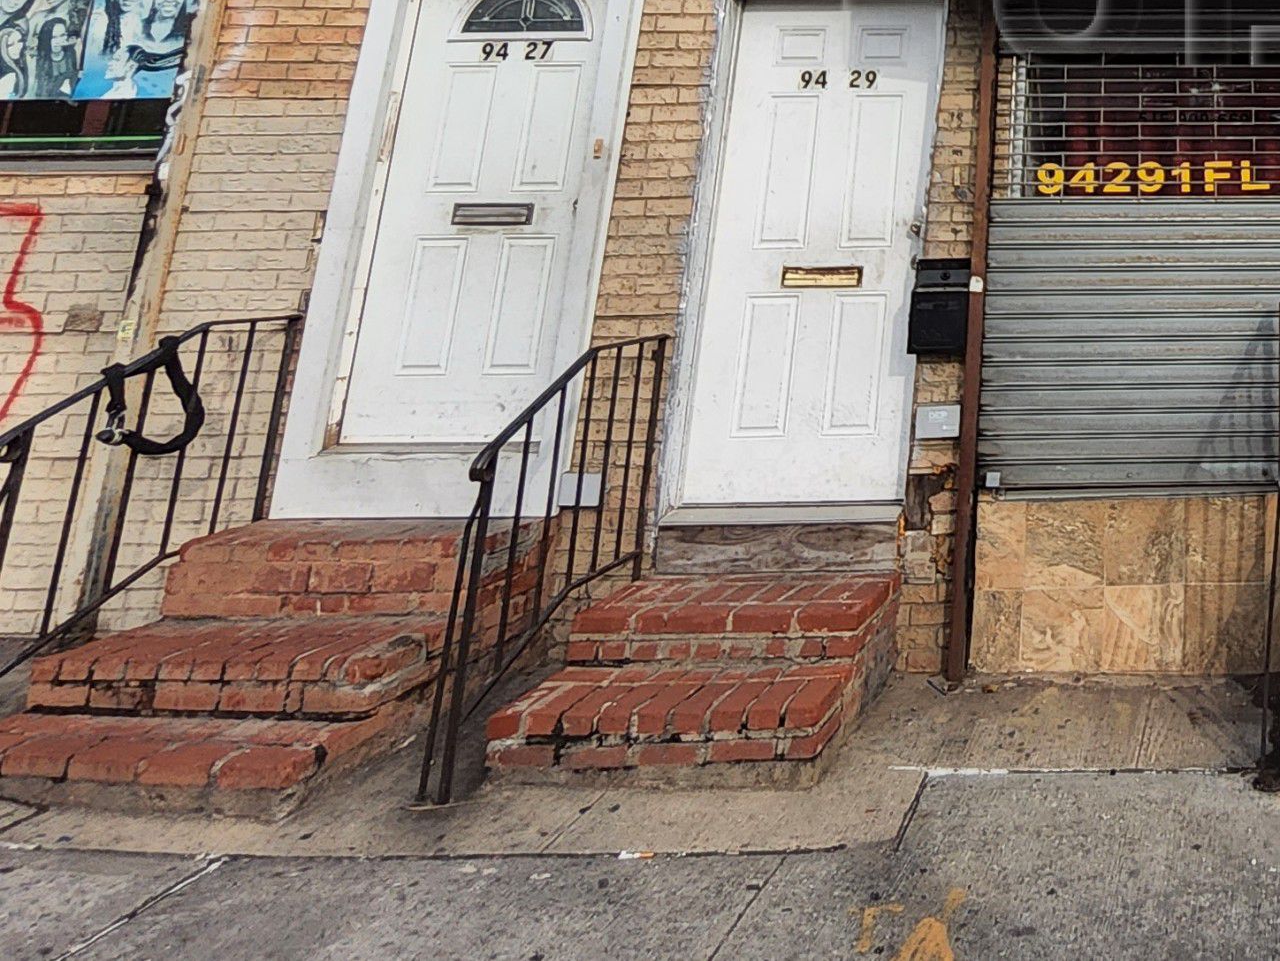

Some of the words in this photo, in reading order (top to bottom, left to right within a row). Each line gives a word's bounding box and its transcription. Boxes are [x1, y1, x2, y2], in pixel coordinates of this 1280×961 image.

[482, 42, 509, 61] 94
[524, 40, 555, 60] 27
[801, 70, 828, 89] 94
[849, 69, 877, 89] 29
[1037, 160, 1270, 194] 94291FL
